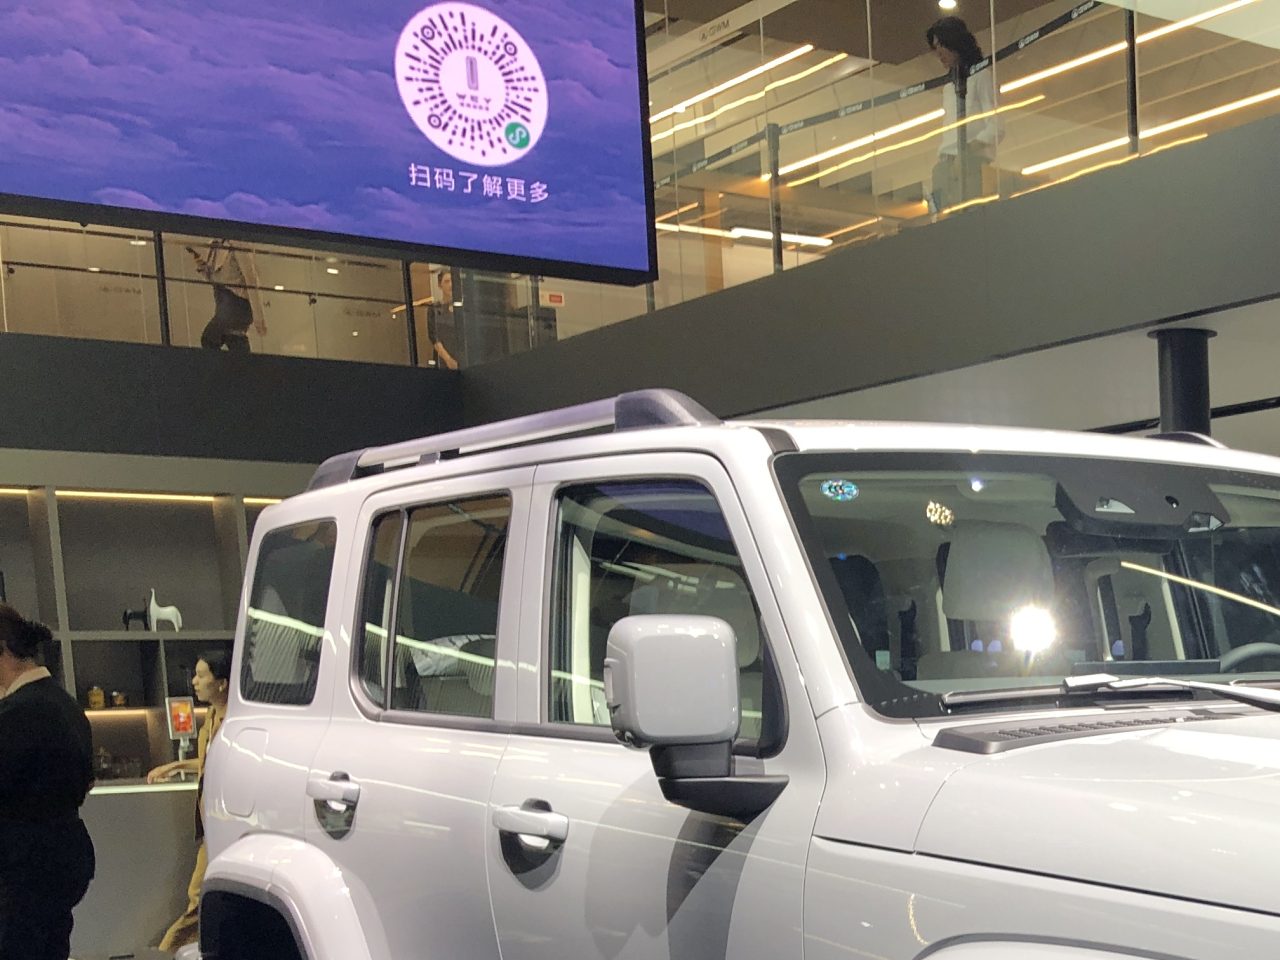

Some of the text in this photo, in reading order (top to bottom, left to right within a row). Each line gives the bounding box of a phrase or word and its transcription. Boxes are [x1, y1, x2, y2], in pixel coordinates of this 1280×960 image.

[409, 163, 549, 203] 扫码了解更多
